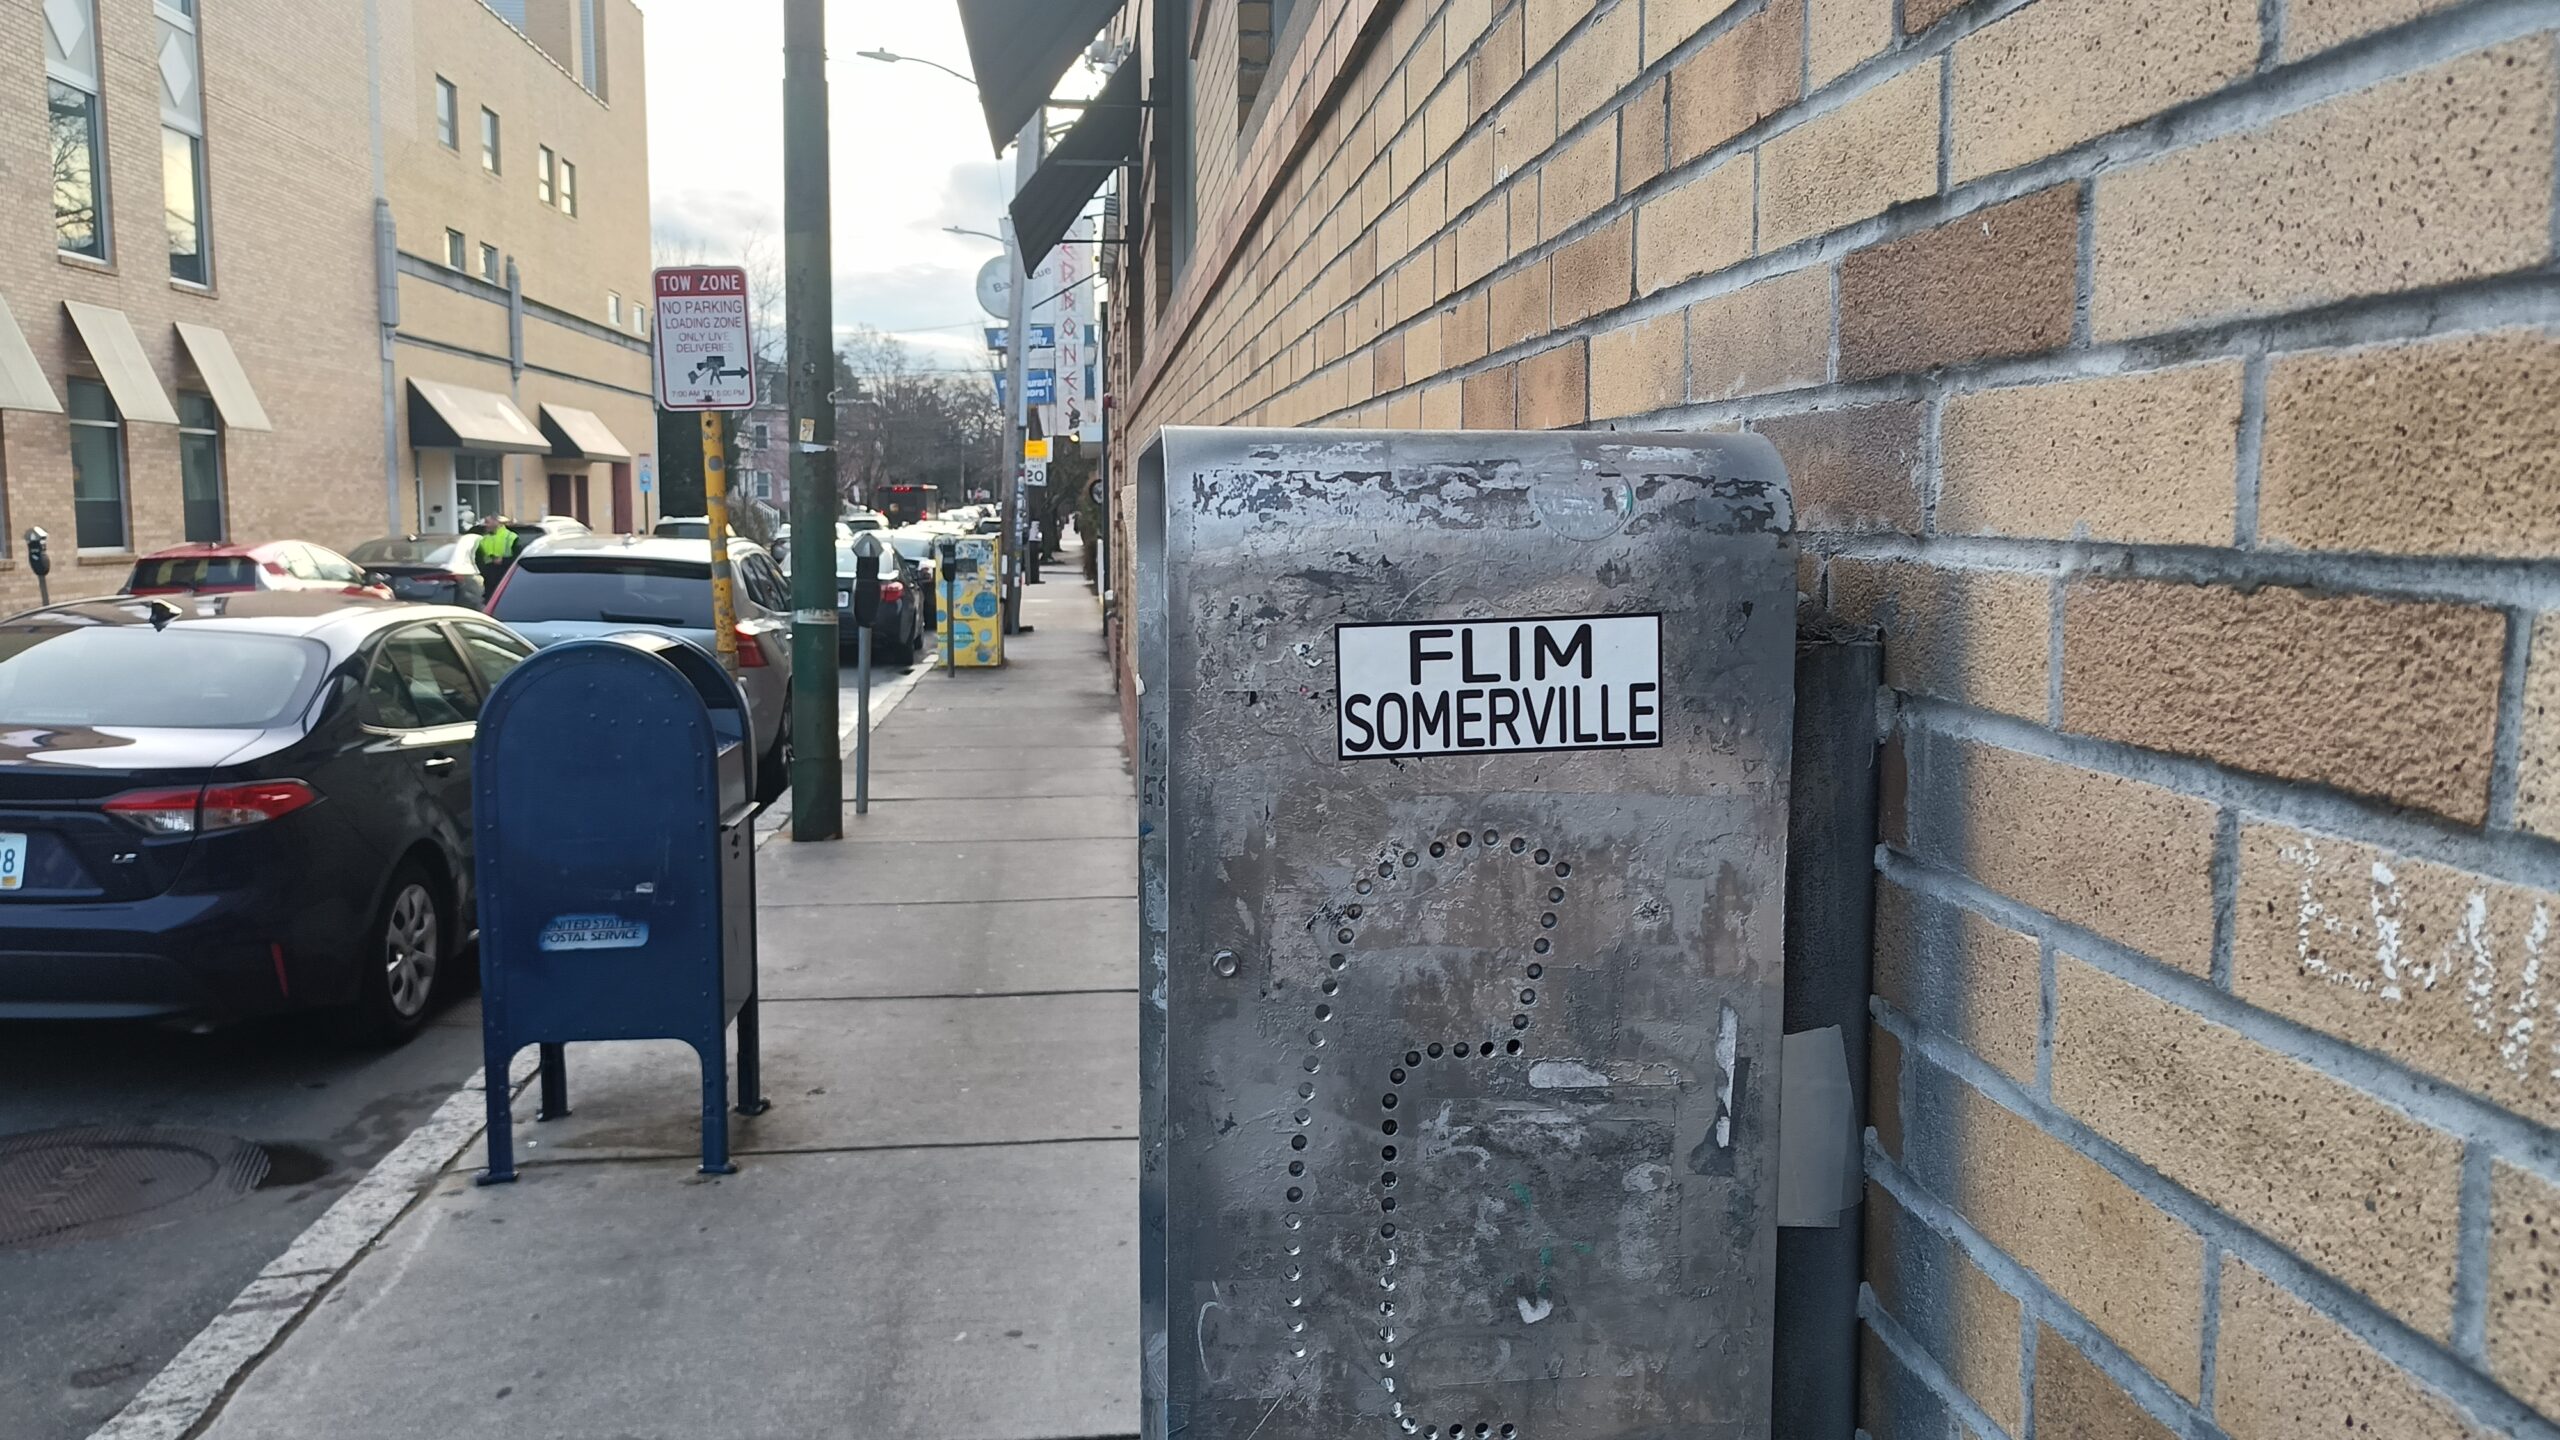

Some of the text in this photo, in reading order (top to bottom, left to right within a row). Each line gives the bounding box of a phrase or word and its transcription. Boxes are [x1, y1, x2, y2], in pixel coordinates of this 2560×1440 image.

[660, 274, 741, 292] TOW ZONE
[662, 300, 743, 314] NO PARKING
[664, 316, 742, 329] LOADING ZONE
[679, 332, 706, 341] ONLY
[676, 343, 735, 353] DELIVERIES
[1027, 470, 1044, 482] 20
[1409, 623, 1592, 686] FLIM
[1345, 682, 1657, 752] SOMERVILLE
[548, 919, 591, 931] UNITED
[542, 929, 641, 943] POSTAL SERVICE
